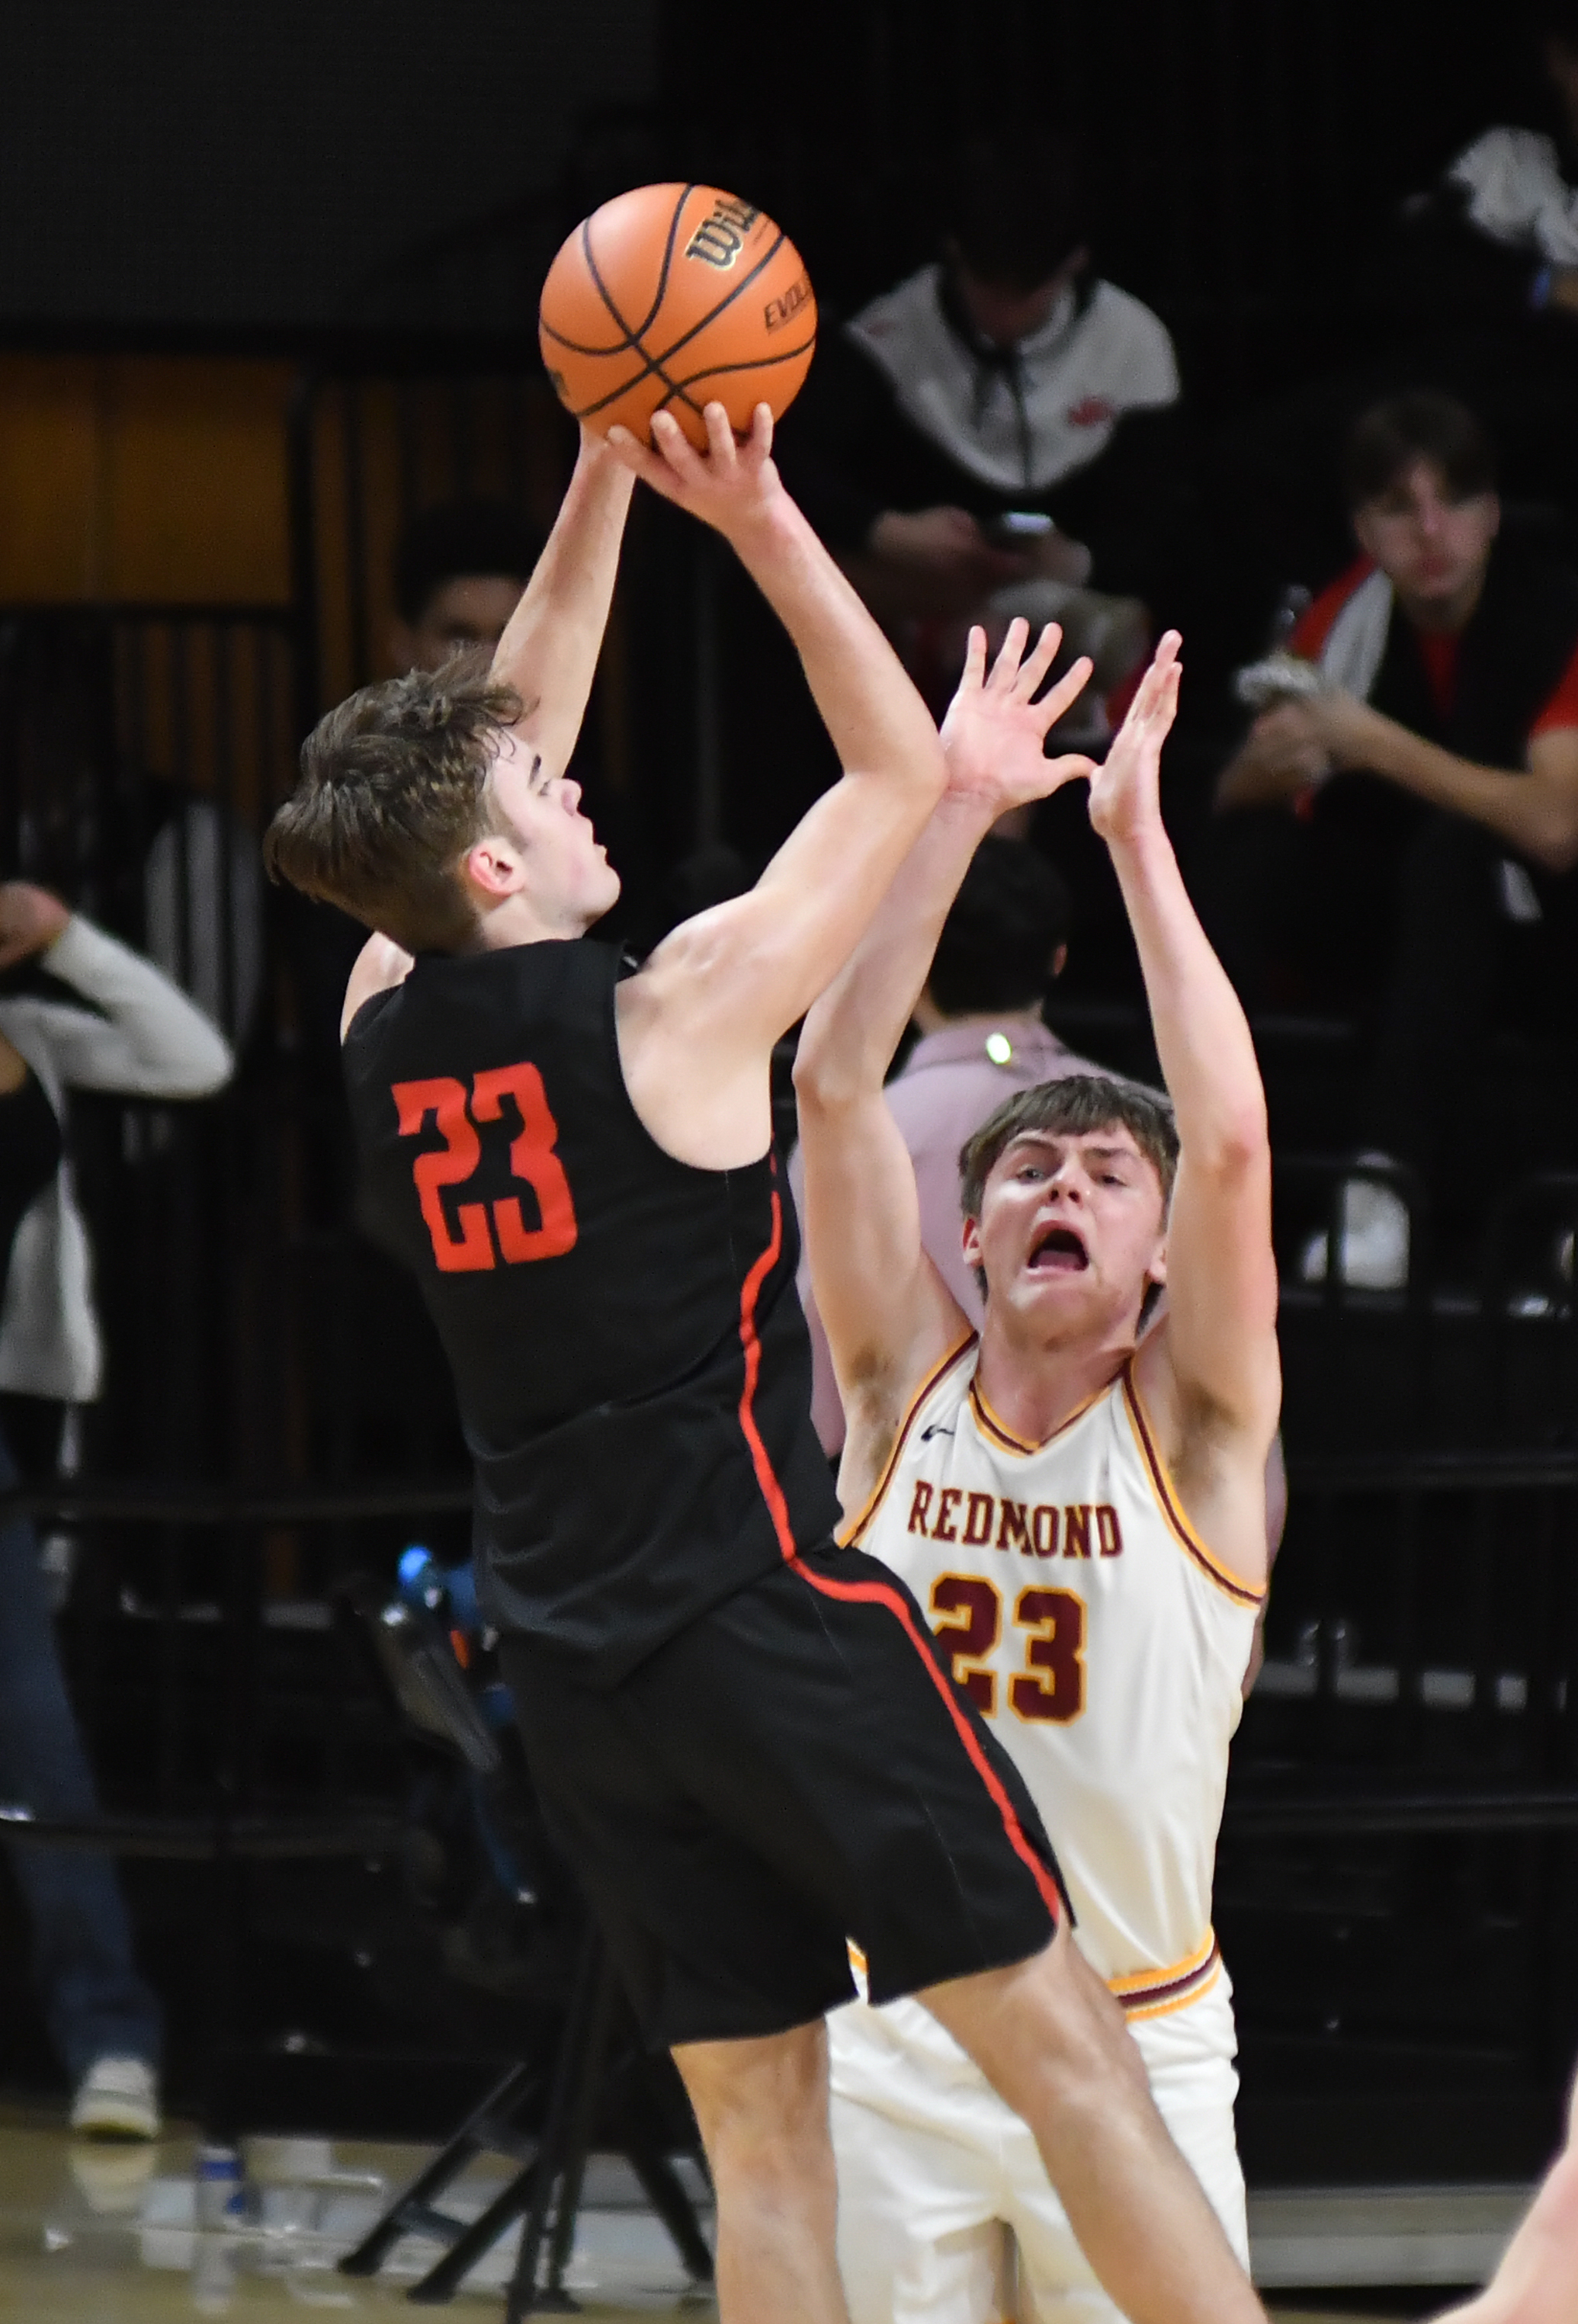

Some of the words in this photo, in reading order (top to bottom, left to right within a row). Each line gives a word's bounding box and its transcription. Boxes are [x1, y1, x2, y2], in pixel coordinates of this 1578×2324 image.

[683, 198, 758, 270] Wil
[764, 276, 813, 328] EVOL
[390, 1061, 578, 1272] 23
[907, 1479, 1124, 1559] REDMOND
[929, 1571, 1088, 1727] 23
